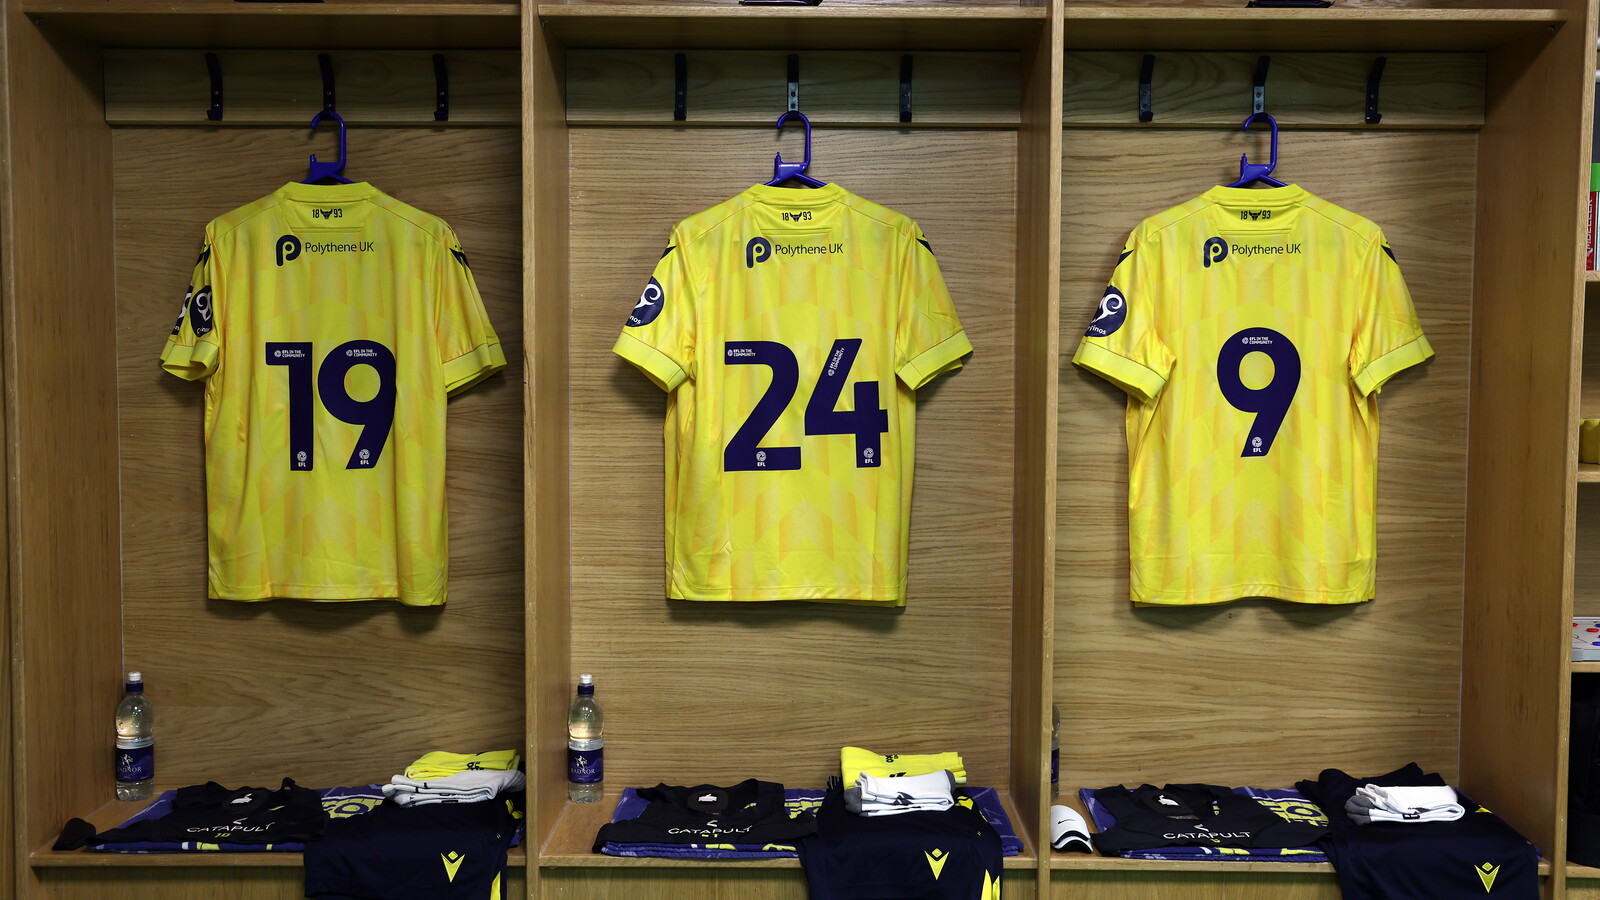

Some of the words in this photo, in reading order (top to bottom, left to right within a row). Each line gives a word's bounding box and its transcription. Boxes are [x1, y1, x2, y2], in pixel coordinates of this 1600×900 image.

[312, 209, 320, 218] 18
[333, 208, 343, 218] 93
[781, 212, 790, 221] 18
[802, 211, 812, 221] 93
[1240, 210, 1248, 220] 18
[1261, 210, 1271, 219] 93
[305, 242, 357, 255] Polythene
[359, 241, 374, 252] UK
[775, 244, 827, 257] Polythene
[828, 243, 843, 254] UK
[1232, 244, 1284, 257] Polythene
[1286, 243, 1301, 254] UK
[1217, 327, 1301, 457] 9
[265, 339, 397, 471] 19
[724, 338, 888, 472] 24
[187, 822, 276, 833] CATAPULT
[668, 825, 753, 834] CATAPULT
